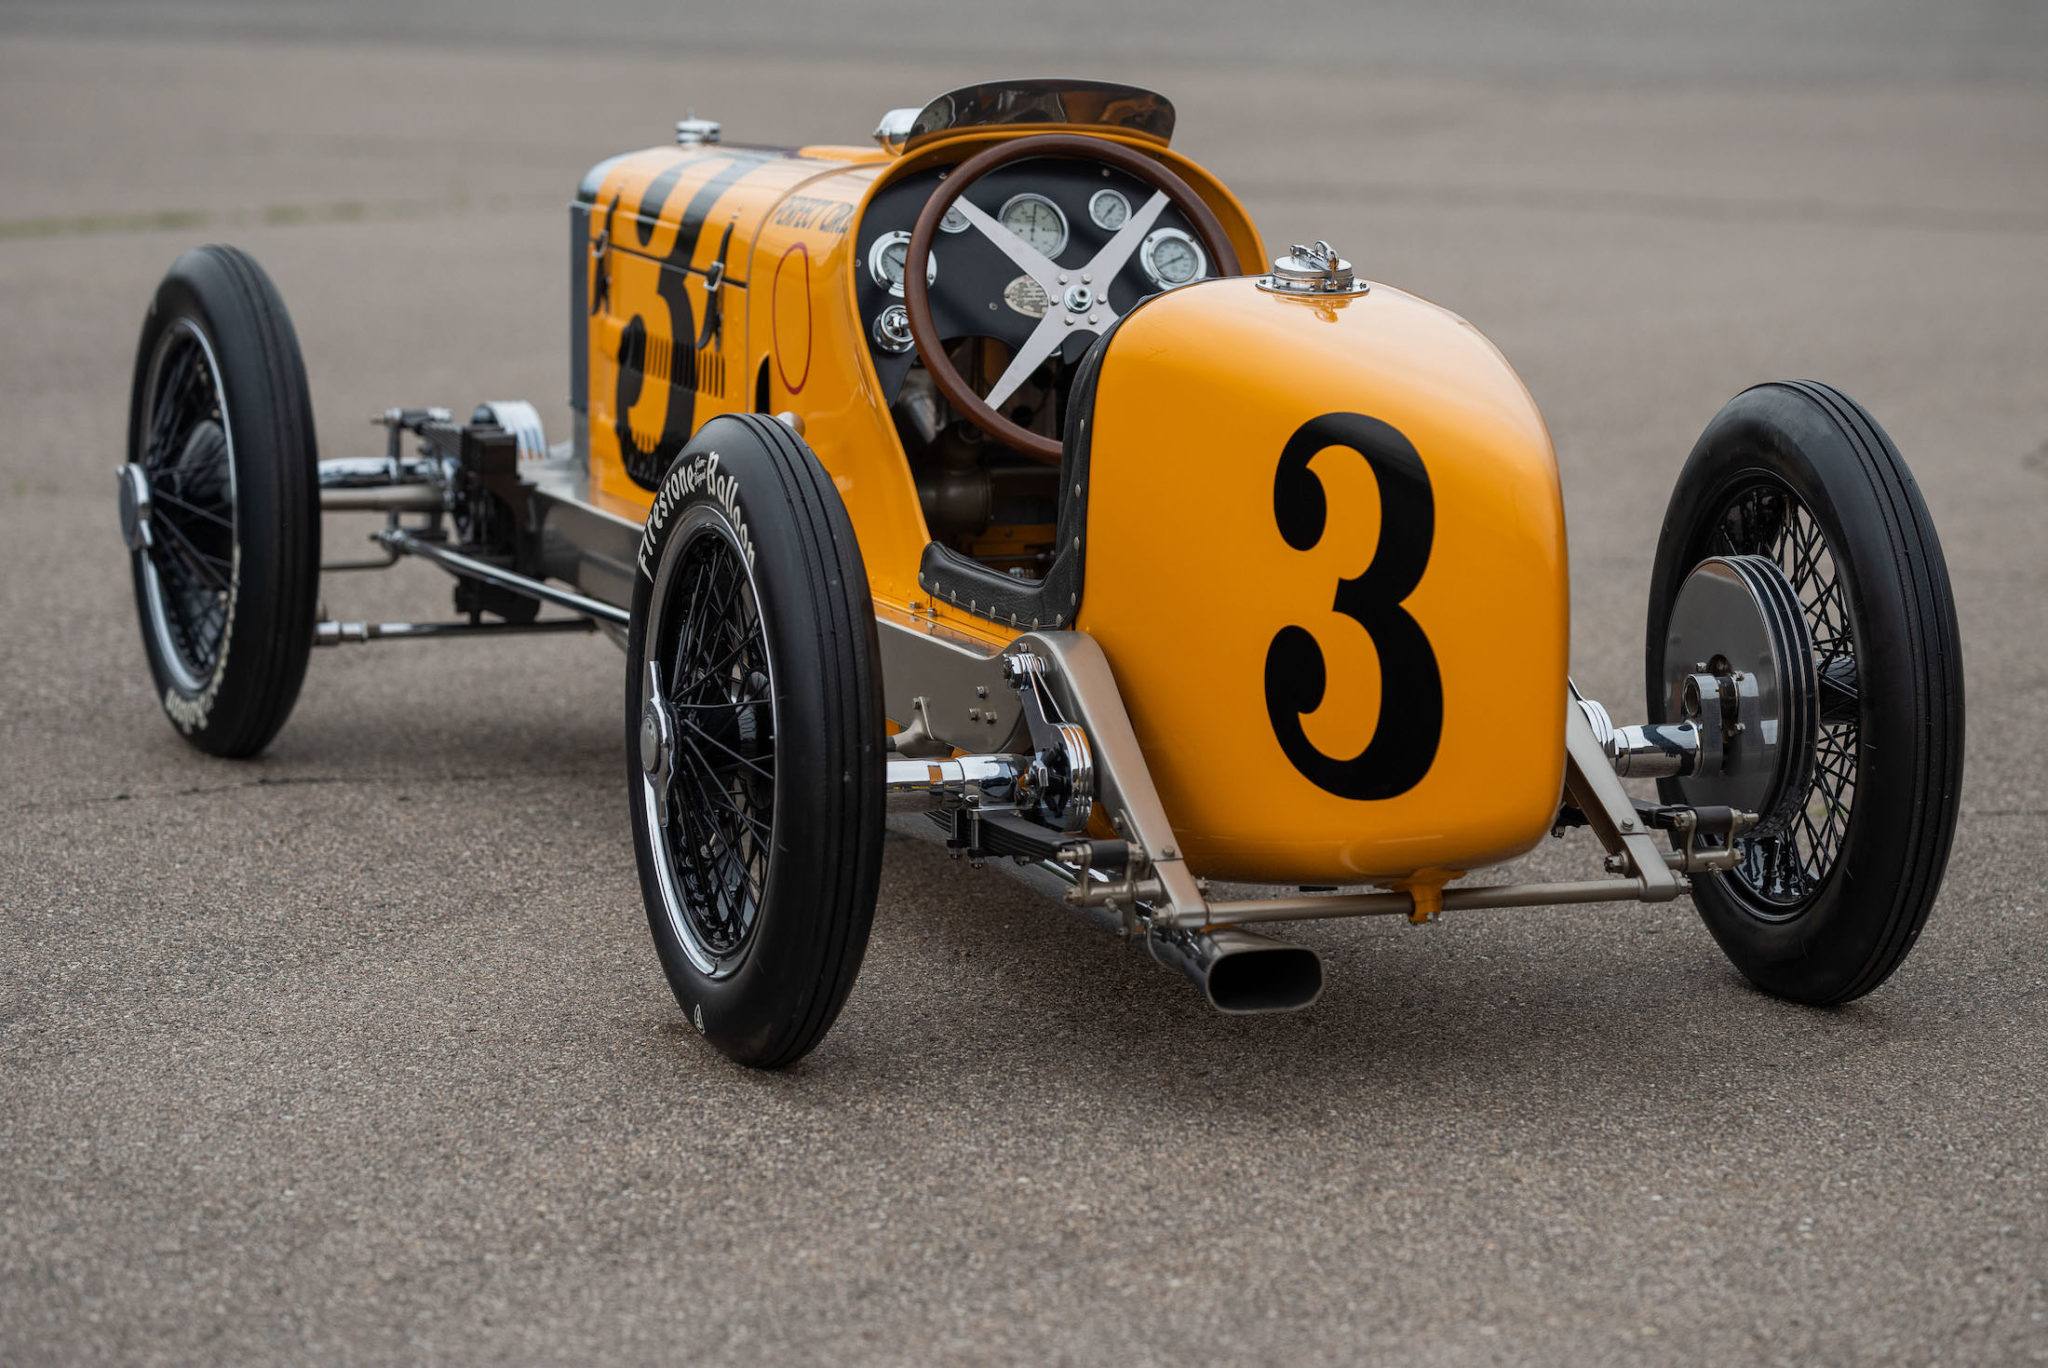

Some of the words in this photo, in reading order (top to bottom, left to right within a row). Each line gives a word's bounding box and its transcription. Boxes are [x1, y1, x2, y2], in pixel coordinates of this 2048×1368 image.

[615, 152, 775, 493] 3
[637, 464, 695, 584] Firestone
[706, 451, 755, 574] Balloon
[1264, 412, 1443, 801] 3
